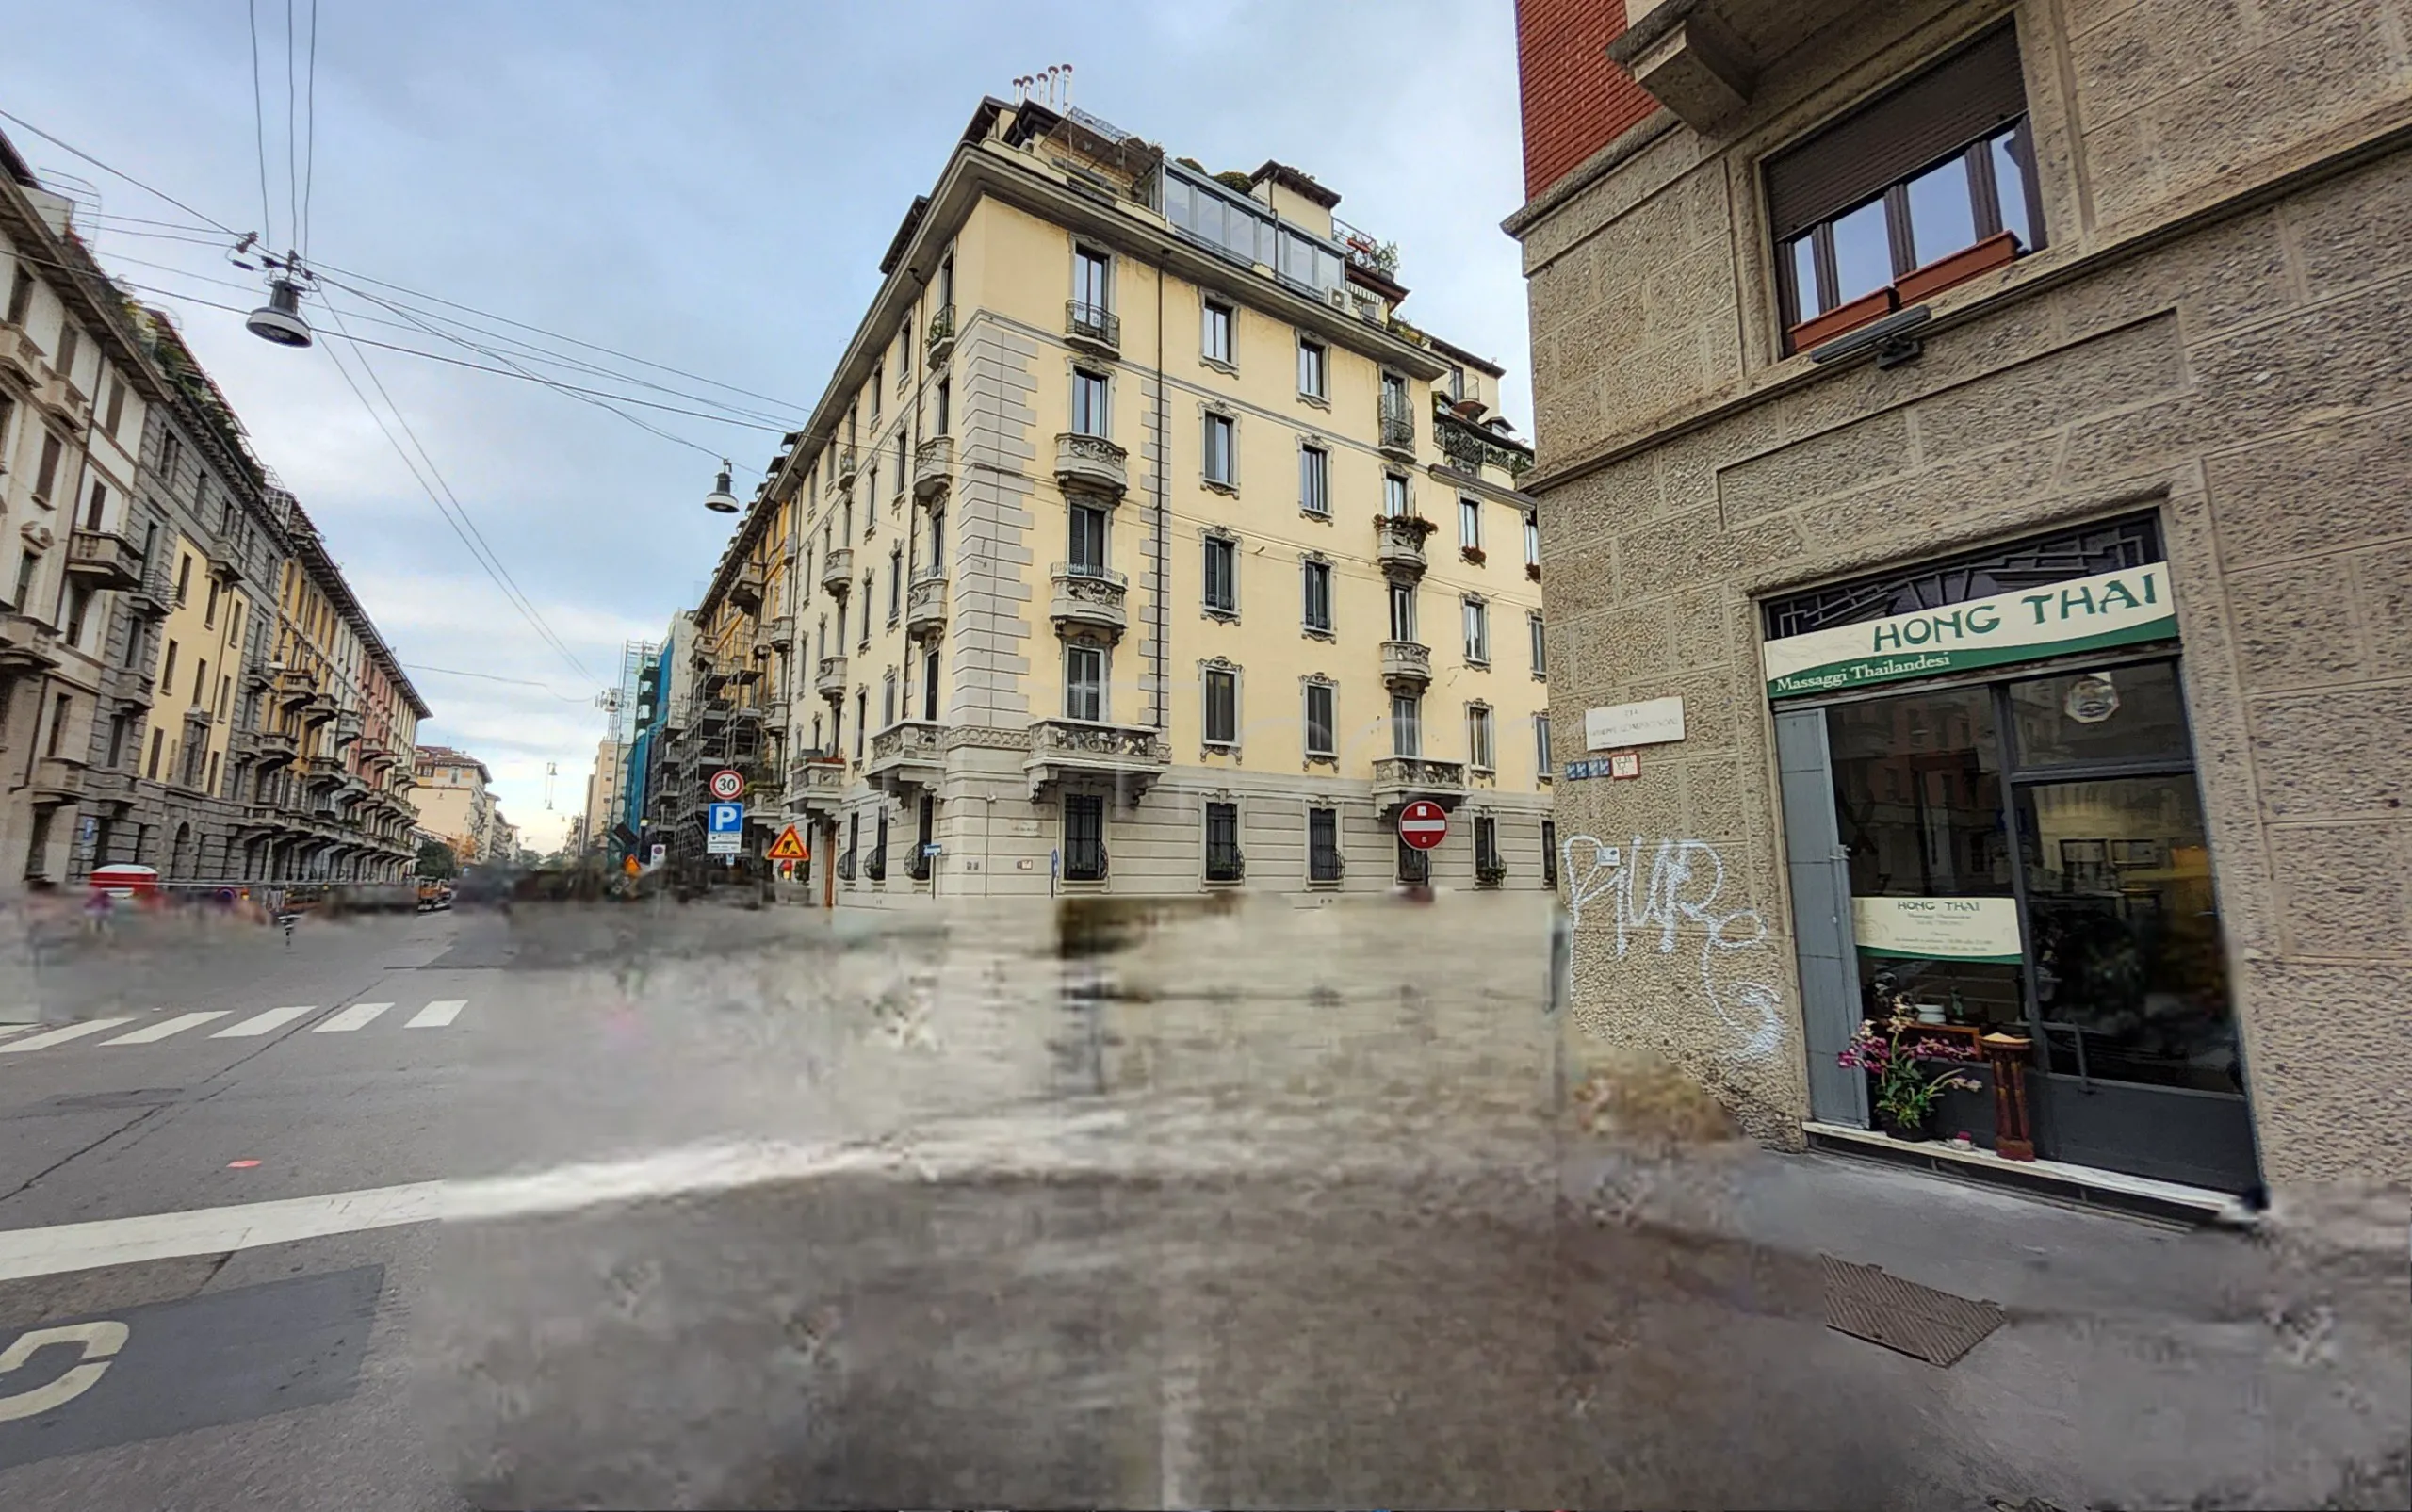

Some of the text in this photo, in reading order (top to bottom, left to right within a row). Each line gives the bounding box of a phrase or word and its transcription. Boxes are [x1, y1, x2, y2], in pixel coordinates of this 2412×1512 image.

[1872, 573, 2159, 652] HONG THAI
[1776, 651, 1950, 692] Massaggi Thailandesi
[718, 778, 736, 791] 30
[715, 806, 737, 830] P
[1898, 901, 1980, 911] HONG THAI
